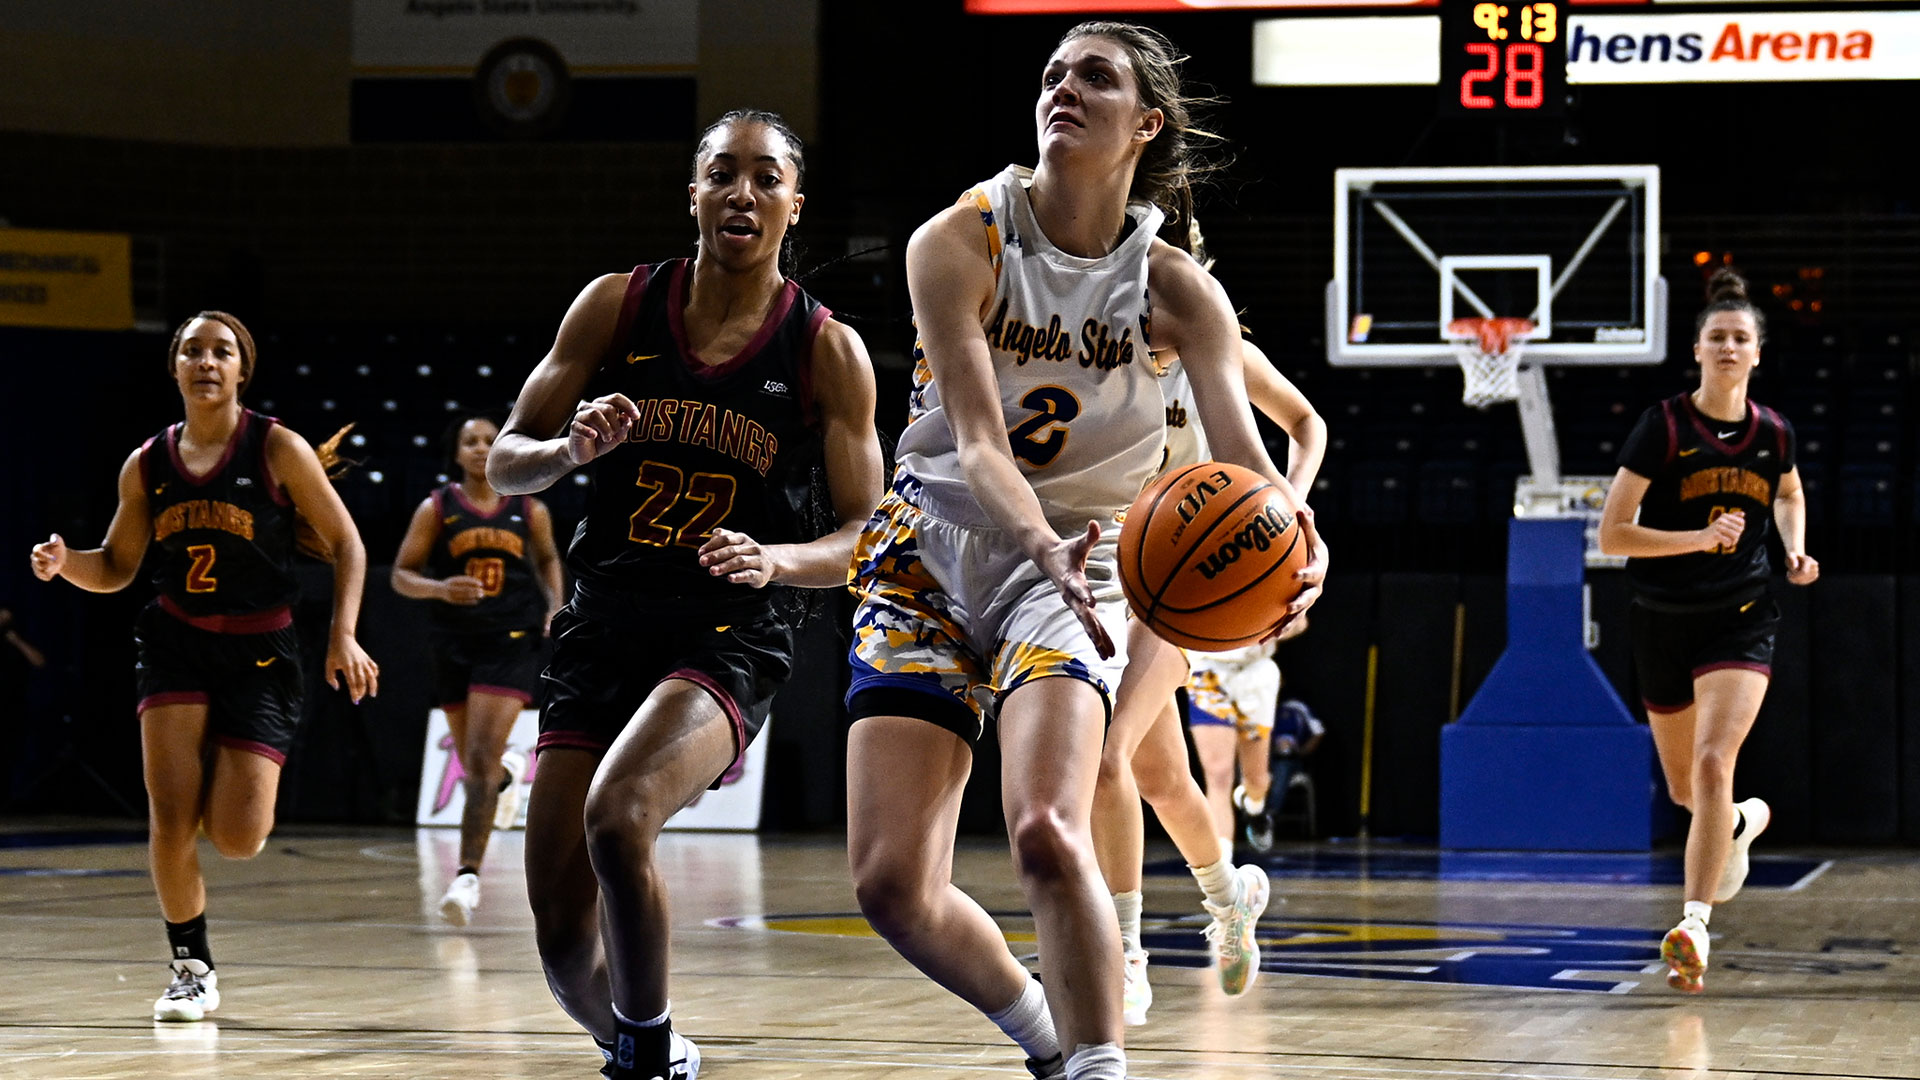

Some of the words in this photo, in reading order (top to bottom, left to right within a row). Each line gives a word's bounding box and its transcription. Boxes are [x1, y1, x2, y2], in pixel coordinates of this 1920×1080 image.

[1473, 2, 1557, 42] 9:13
[1709, 22, 1874, 63] Arena
[1460, 42, 1544, 109] 28
[987, 297, 1072, 367] Angelo
[1078, 317, 1134, 372] State
[620, 398, 778, 478] USTANGS
[1008, 383, 1082, 470] 2
[628, 459, 737, 550] 22
[1195, 503, 1294, 580] Wilson
[186, 543, 218, 593] 2
